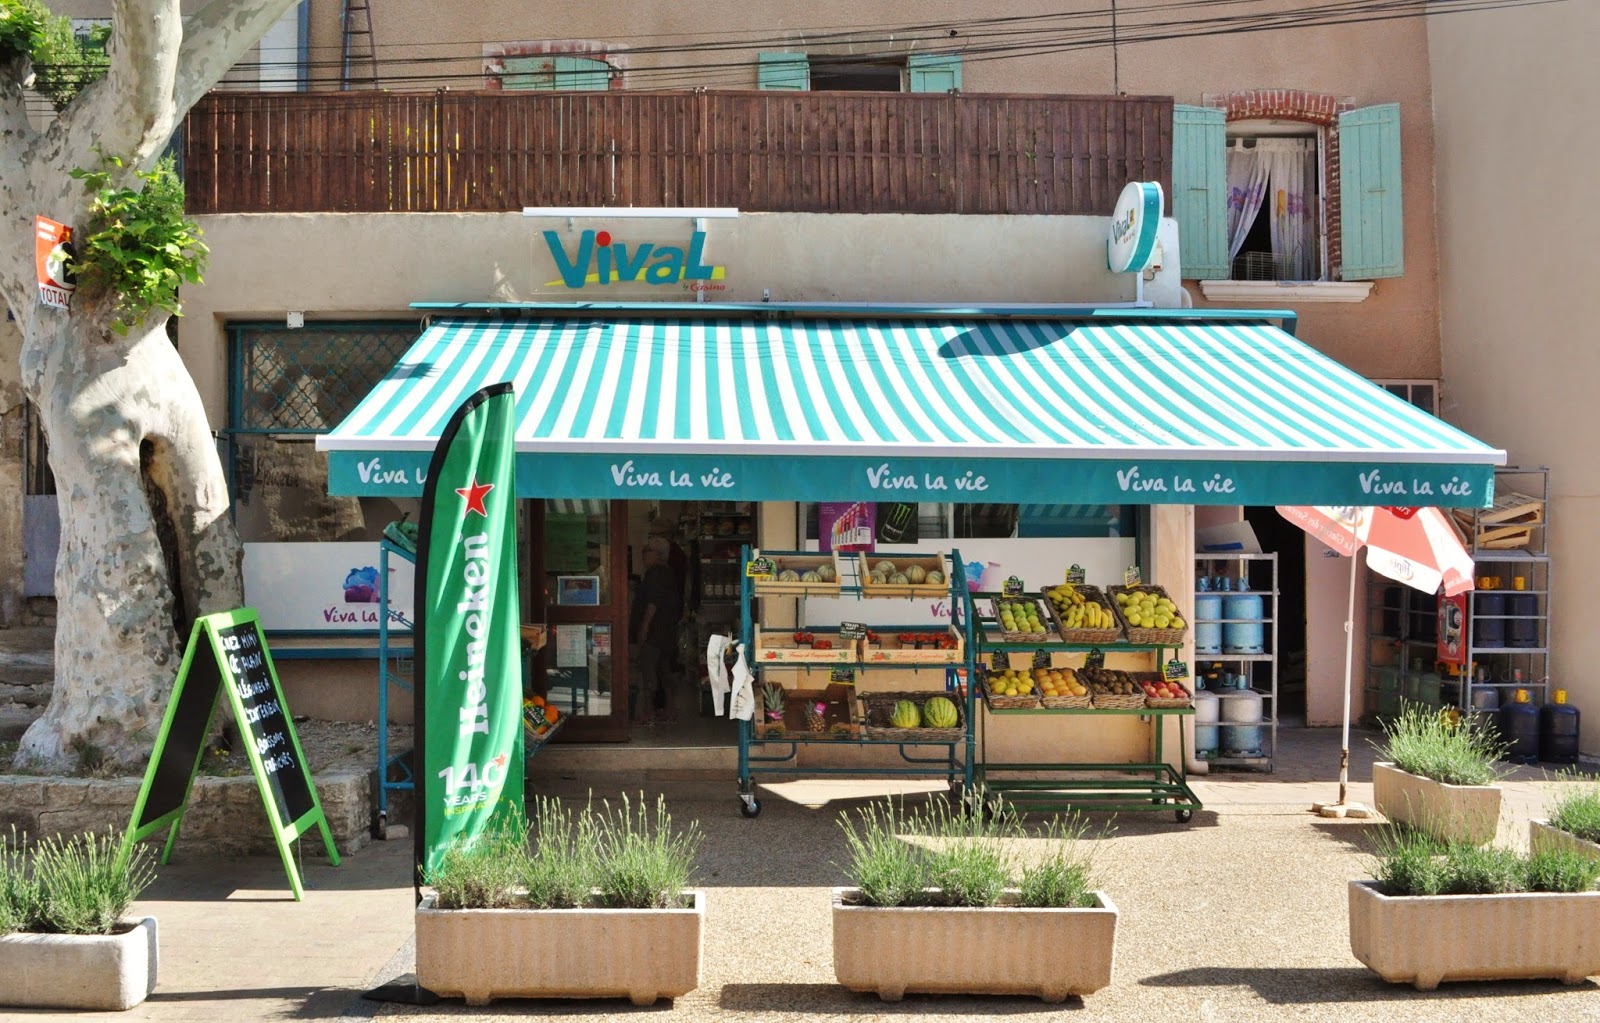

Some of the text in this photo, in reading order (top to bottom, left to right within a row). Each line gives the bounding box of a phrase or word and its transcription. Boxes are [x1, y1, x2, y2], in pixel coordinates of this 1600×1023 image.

[41, 287, 70, 306] TOTAL
[690, 284, 726, 292] Casino
[357, 457, 409, 484] Viva
[611, 460, 663, 486] Viva
[701, 467, 735, 488] vie
[866, 463, 918, 491] Viva
[954, 470, 989, 491] vie
[1116, 465, 1168, 493] Viva
[1203, 473, 1236, 493] vie
[1359, 469, 1407, 495] Viva
[1440, 476, 1472, 496] vie
[324, 607, 357, 622] Viva
[458, 531, 490, 739] Heineken
[438, 761, 506, 795] 140
[443, 791, 487, 807] YEARS
[444, 796, 505, 817] INSPIRAN
